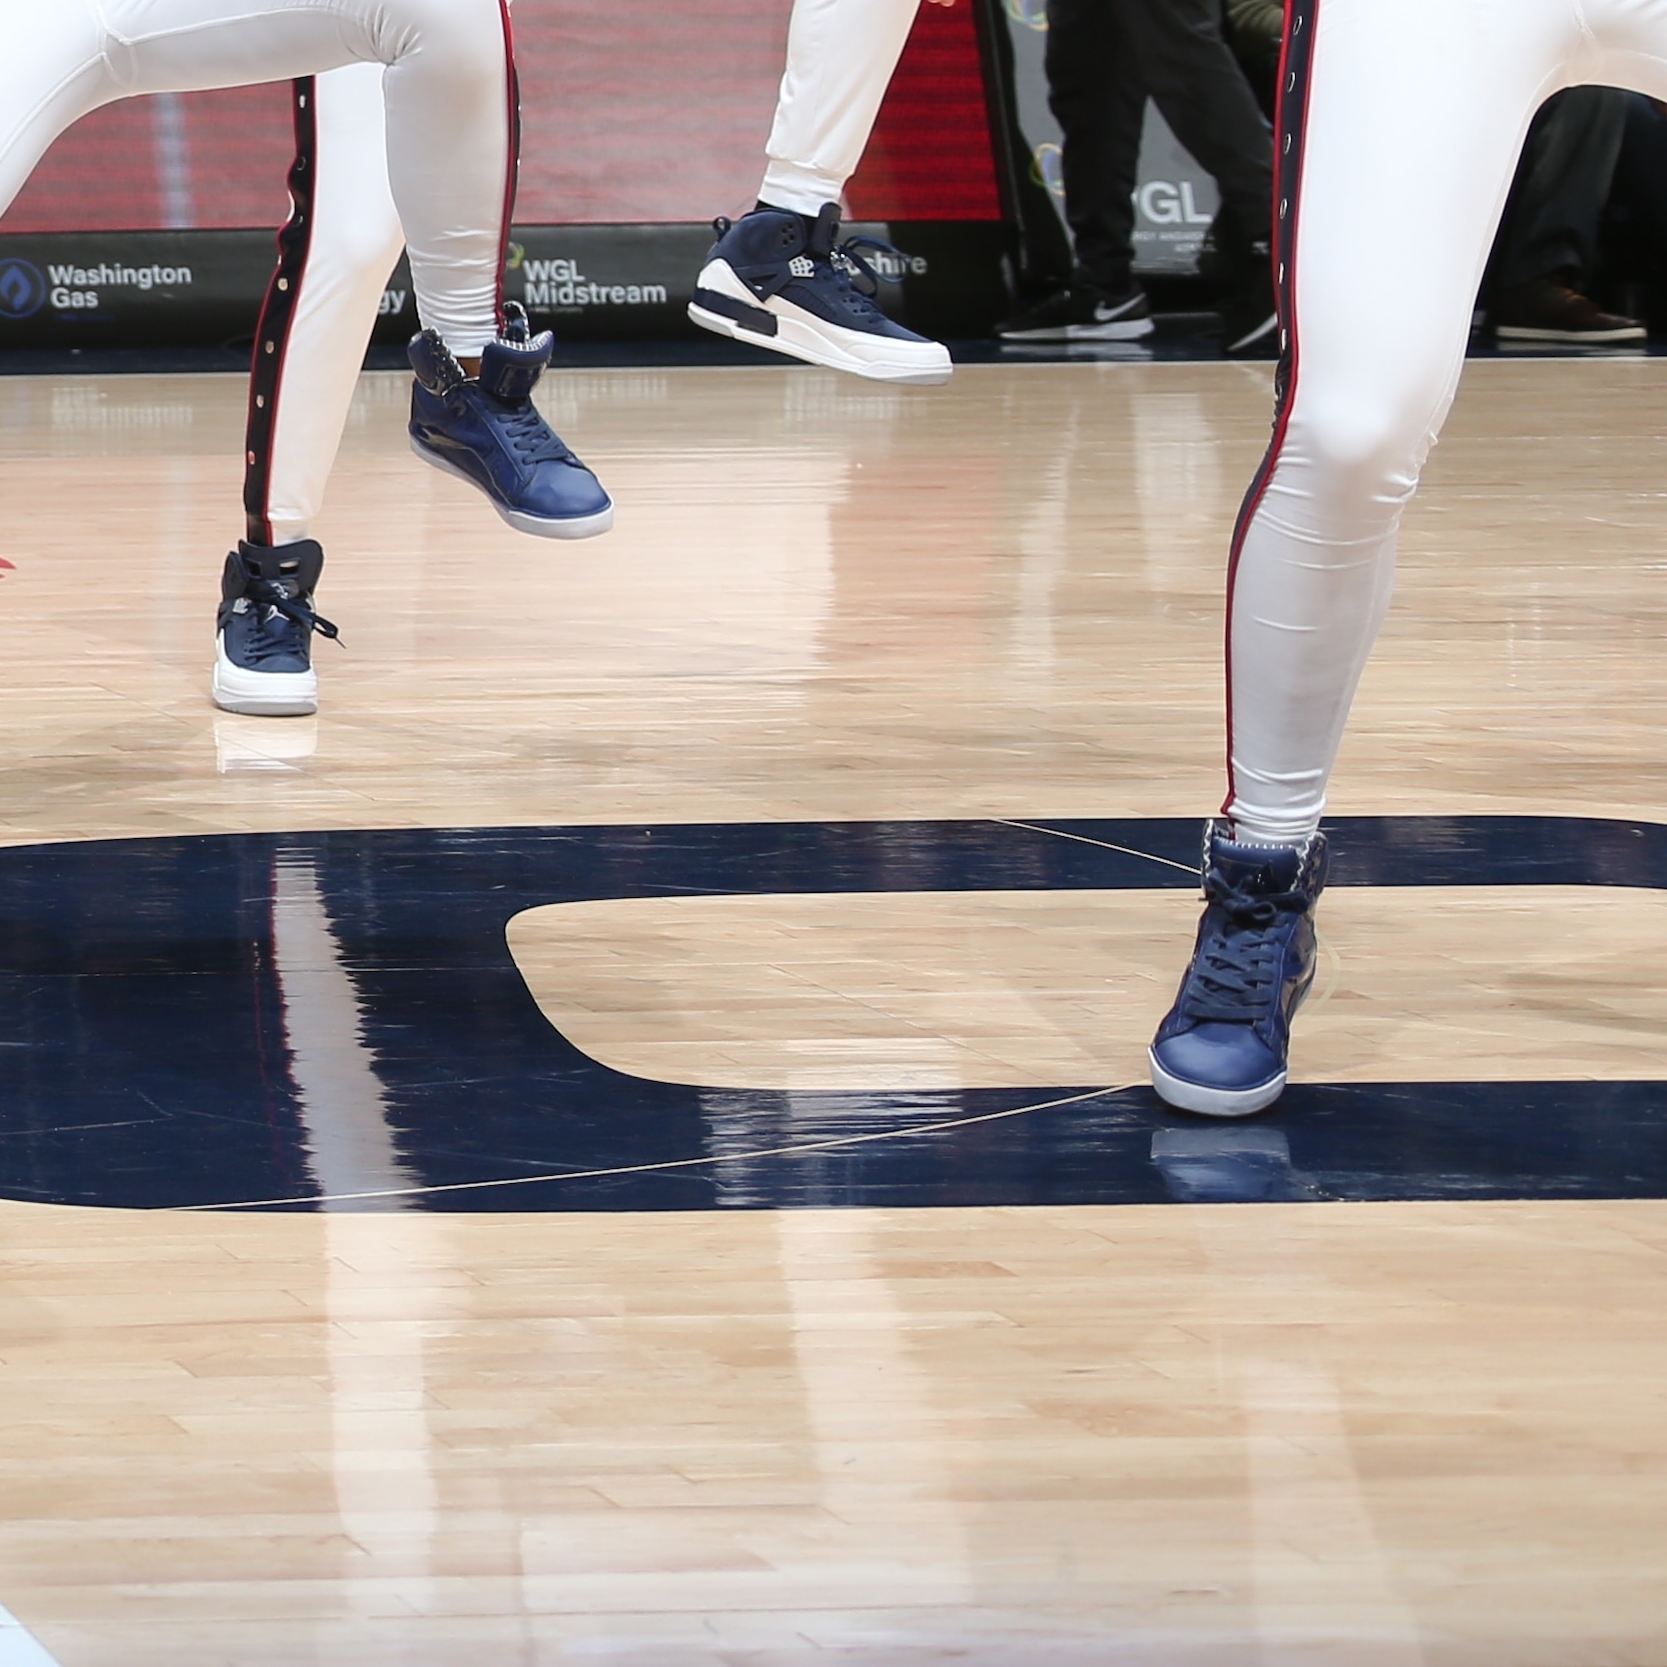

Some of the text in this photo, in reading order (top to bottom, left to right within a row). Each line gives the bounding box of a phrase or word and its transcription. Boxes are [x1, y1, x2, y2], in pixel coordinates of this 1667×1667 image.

[1130, 180, 1214, 225] GL
[48, 263, 192, 290] Washington
[524, 259, 585, 282] WGL
[50, 287, 99, 309] Gas
[524, 281, 667, 305] Midstream
